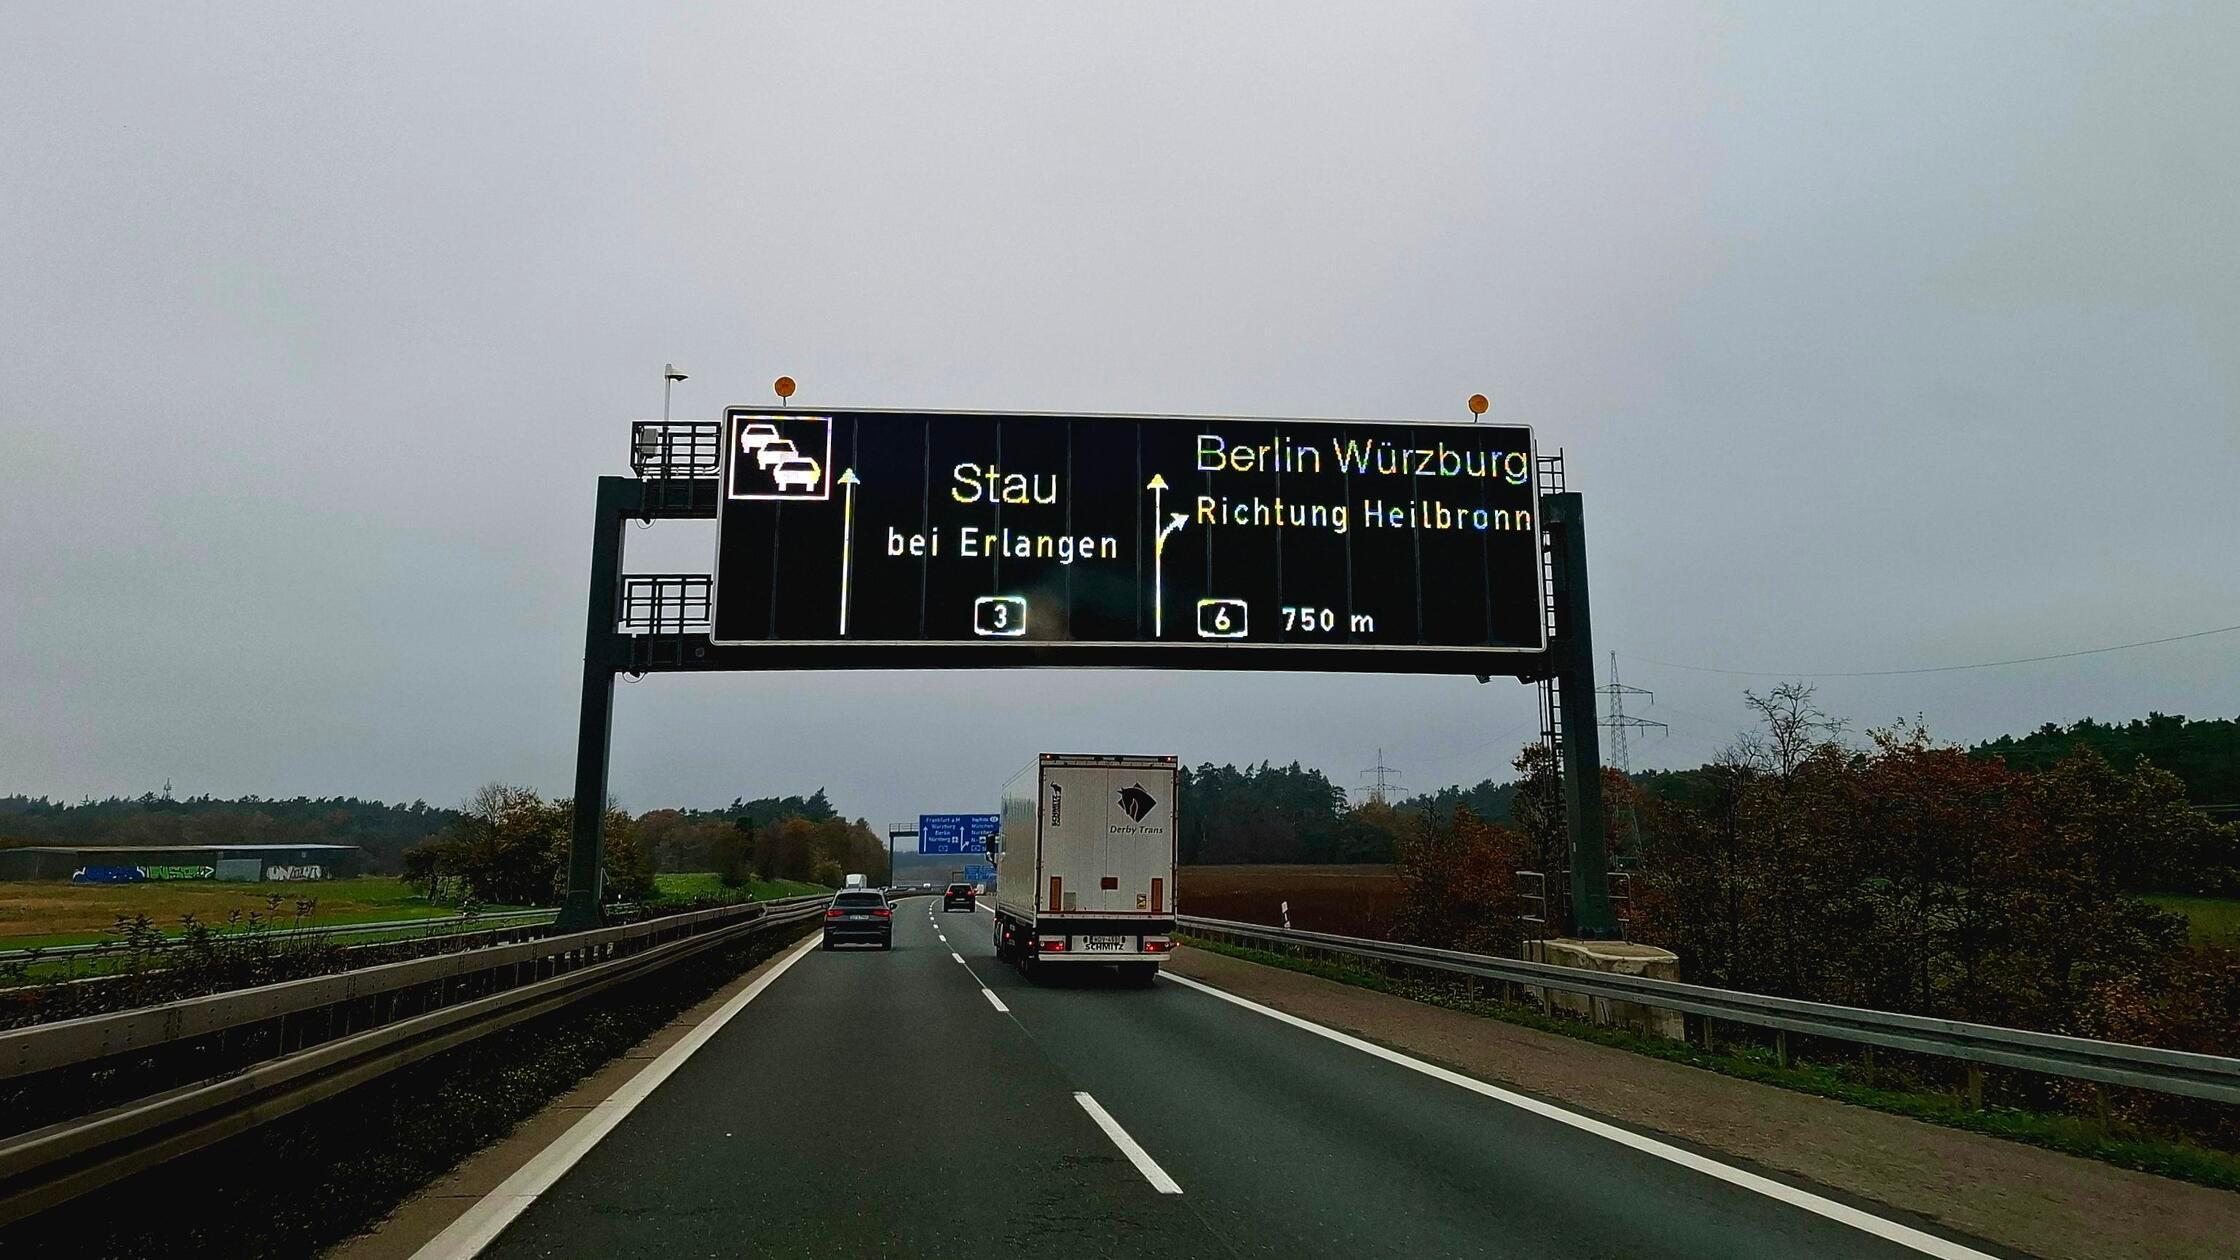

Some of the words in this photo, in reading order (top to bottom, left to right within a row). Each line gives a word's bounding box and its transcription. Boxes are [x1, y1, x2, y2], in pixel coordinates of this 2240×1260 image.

[1198, 435, 1319, 472] Berlin
[1333, 437, 1528, 484] Würzburg
[952, 463, 1056, 504] Stau
[1198, 496, 1347, 533] Richtung
[1365, 500, 1531, 530] Heilbronn
[888, 527, 937, 556] bei
[961, 527, 1116, 564] Erlangen
[993, 604, 1007, 629] 3
[1215, 607, 1230, 630] 6
[1282, 608, 1334, 631] 750
[1351, 615, 1373, 632] m
[1110, 825, 1137, 836] Derby
[1139, 826, 1164, 834] Trans
[1085, 943, 1124, 951] SCHMITZ
